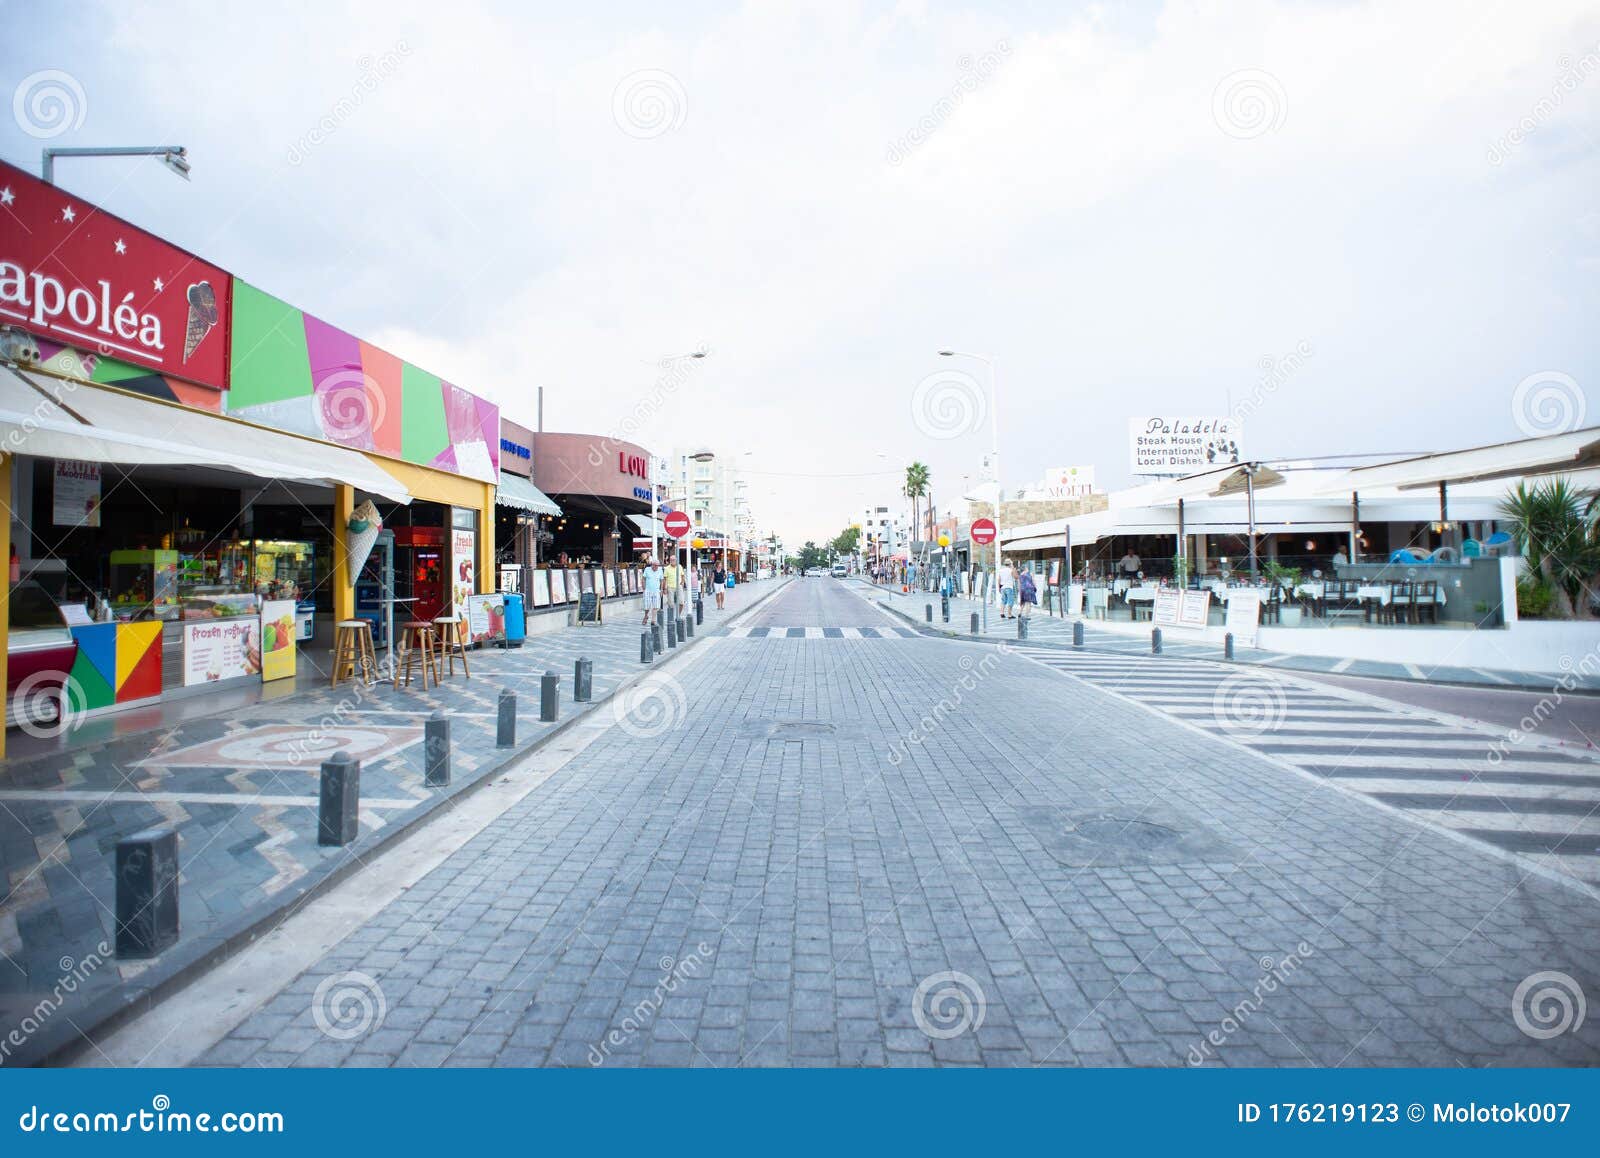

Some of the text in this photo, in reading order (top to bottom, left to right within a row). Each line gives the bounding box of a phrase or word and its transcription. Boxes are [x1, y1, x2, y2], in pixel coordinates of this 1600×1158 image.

[0, 261, 165, 350] apoléa
[1145, 417, 1228, 434] Paladela
[1137, 436, 1203, 445] Steak House
[1137, 447, 1203, 456] International
[1137, 457, 1204, 466] Local Dishes
[191, 623, 252, 641] frozen yoghurt
